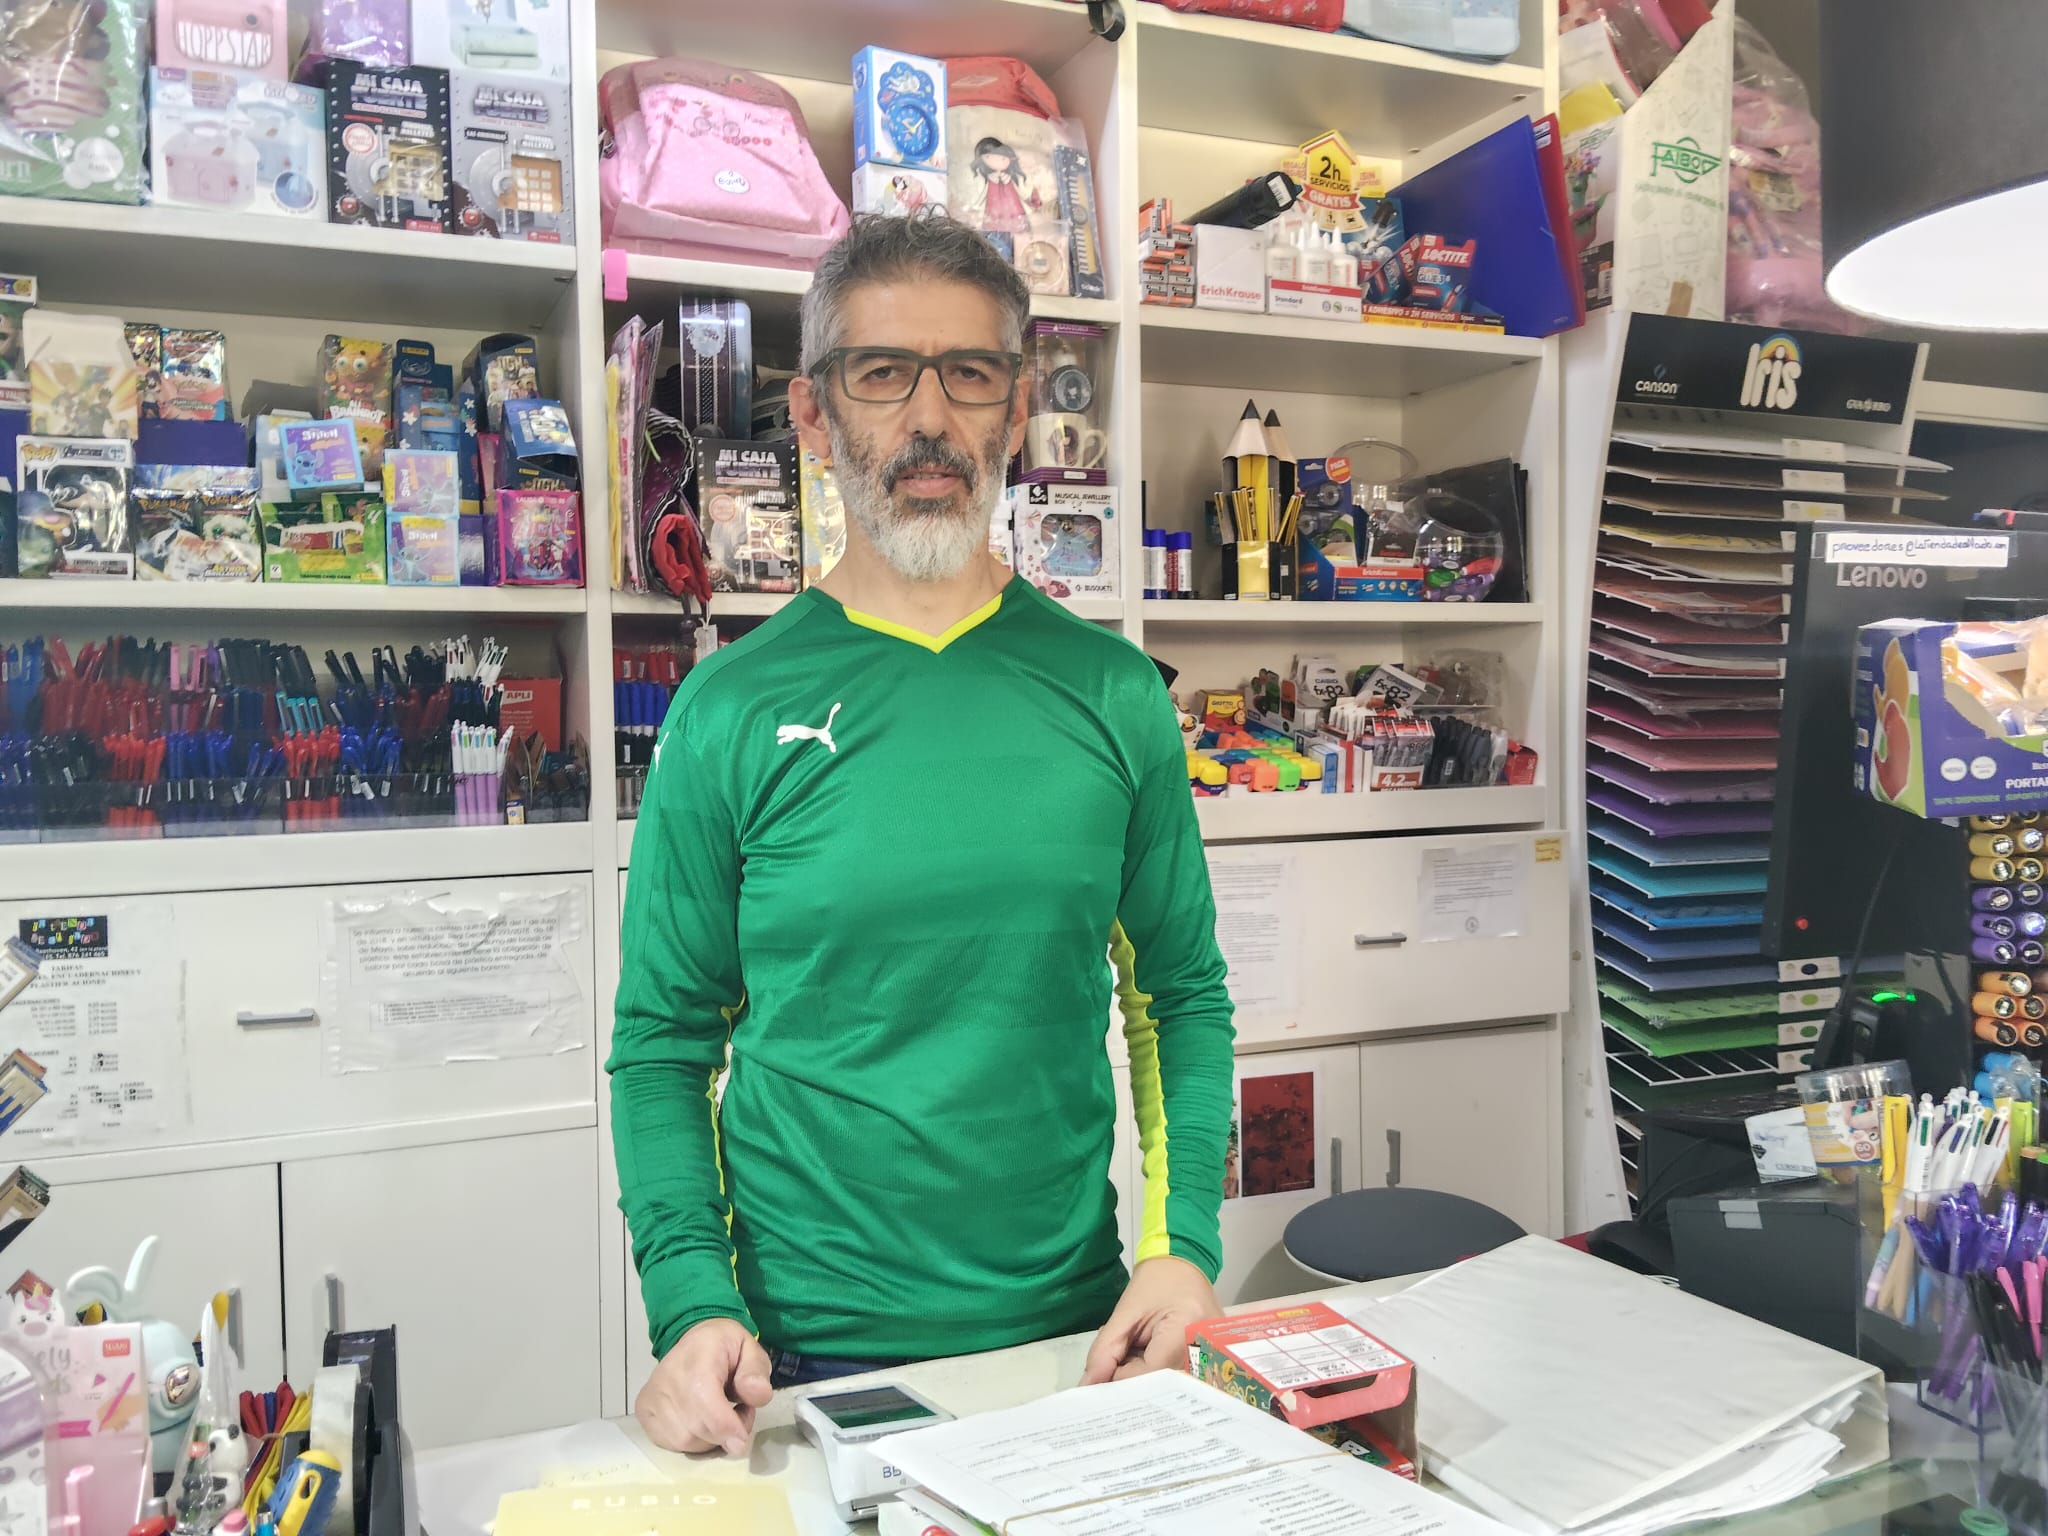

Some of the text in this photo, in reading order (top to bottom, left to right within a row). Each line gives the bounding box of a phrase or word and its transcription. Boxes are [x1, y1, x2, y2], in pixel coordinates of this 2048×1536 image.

[381, 76, 424, 94] CAJA
[503, 89, 544, 107] CAJA
[1320, 156, 1341, 181] 2h
[1310, 177, 1351, 192] SERVICIOS
[1308, 190, 1352, 208] GRATIS
[1422, 248, 1470, 264] LOCTITE
[1200, 284, 1262, 301] ErichKrause
[1635, 380, 1678, 395] CANSON
[718, 449, 778, 464] MI CAJA
[1055, 492, 1112, 500] MUSICAL JEWELLERY
[1836, 563, 1928, 590] Lenovo
[506, 691, 531, 700] APLI
[1313, 685, 1346, 699] fx-82
[1374, 677, 1412, 703] fx-82
[572, 1494, 718, 1511] RUBIO
